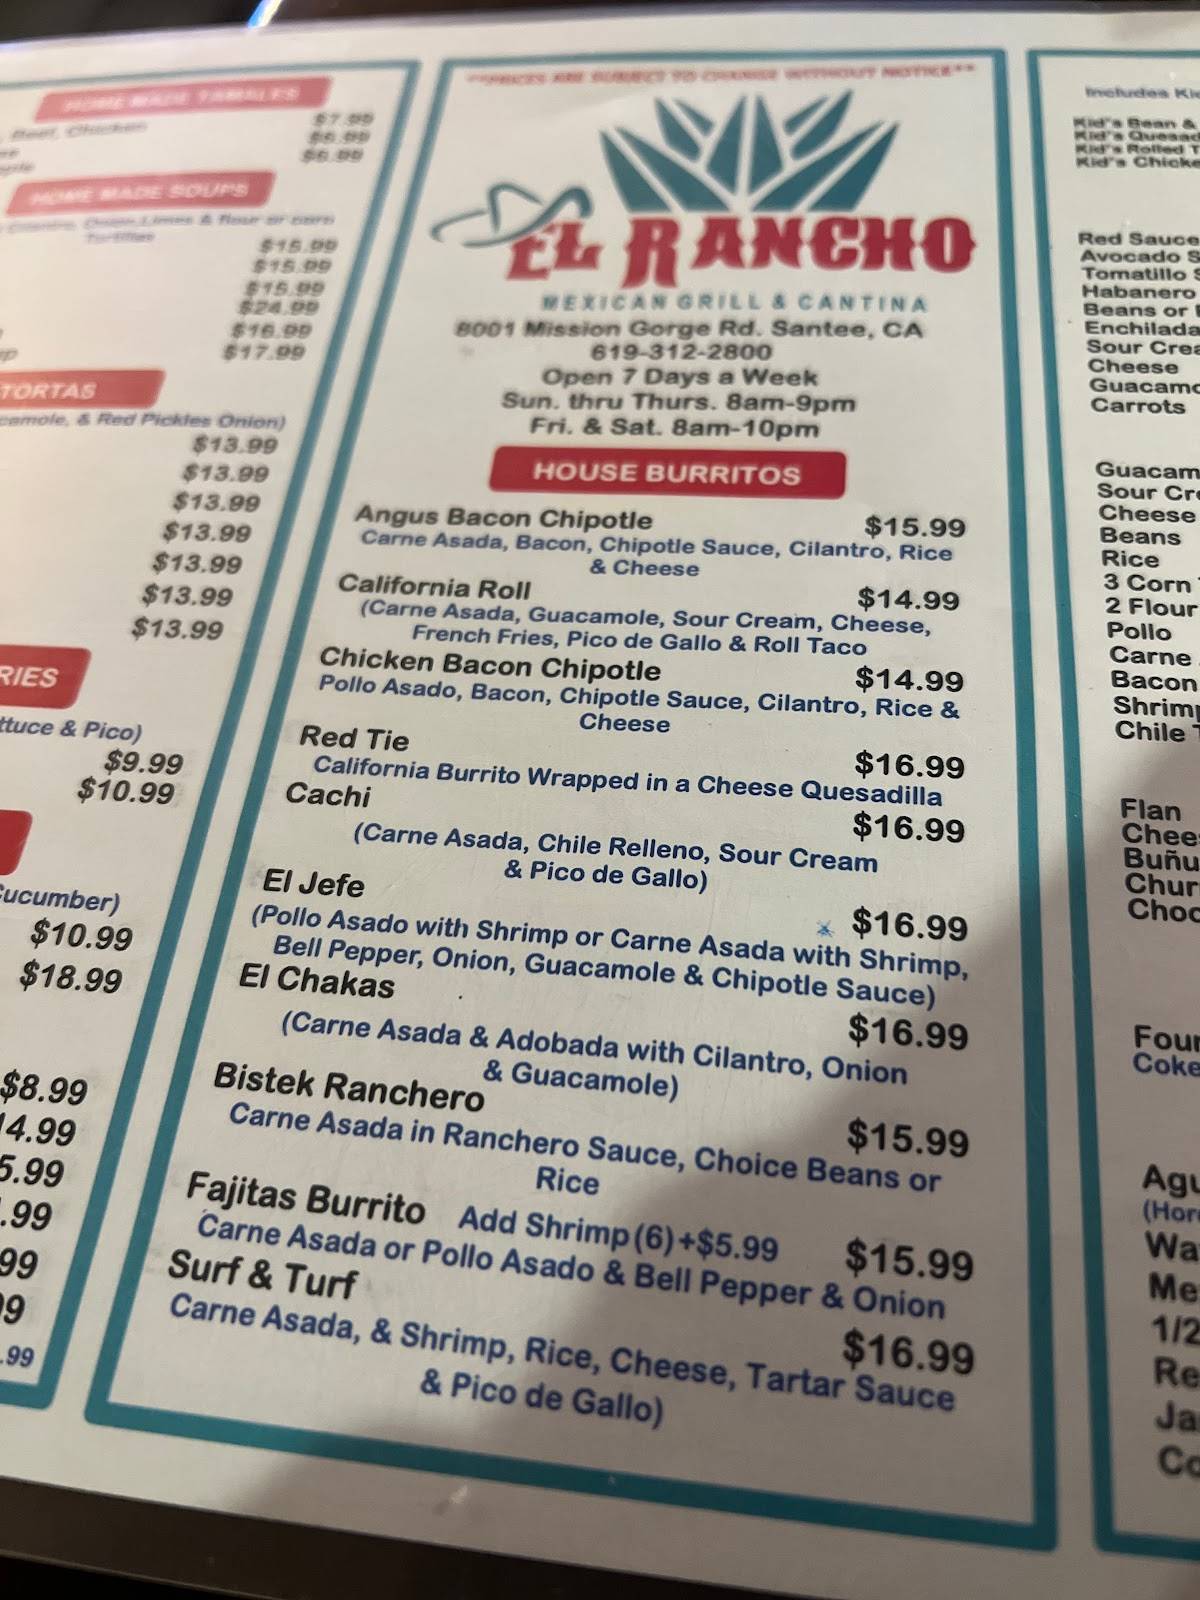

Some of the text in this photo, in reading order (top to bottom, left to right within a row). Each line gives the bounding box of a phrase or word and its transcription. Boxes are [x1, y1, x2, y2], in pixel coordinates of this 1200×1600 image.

[1073, 117, 1196, 129] Kid's Bean &
[1074, 131, 1123, 142] Kid's
[1075, 144, 1183, 155] Kid's Rolled
[1076, 157, 1126, 168] Kid's
[1079, 233, 1200, 246] Red Sauce
[505, 216, 977, 289] EL RANCHO
[1080, 251, 1181, 264] Avocado
[1082, 267, 1187, 281] Tomatillo
[1082, 285, 1196, 299] Habanero
[541, 294, 929, 314] MEXICAN GRILL & CANTINA
[1084, 304, 1188, 317] Beans or
[455, 319, 923, 340] 8001 Mission Gorge Rd. Santee, CA
[221, 344, 305, 362] $17.99
[592, 344, 772, 360] 619-312-2800
[1087, 340, 1142, 355] Sour
[542, 368, 818, 388] Open 7 Days a Week
[1088, 359, 1178, 374] Cheese
[1, 382, 97, 400] TORTAS
[502, 391, 856, 416] Sun. thru Thurs. 8am-9pm
[1091, 399, 1186, 415] Carrots
[77, 413, 286, 432] & Red Pickles Onion)
[531, 416, 819, 440] Fri. & Sat. 8am-10pm
[191, 434, 278, 456] $13.99
[182, 463, 269, 484] $13.99
[534, 463, 800, 485] HOUSE BURRITOS
[172, 491, 261, 513] $13.99
[1098, 483, 1157, 500] Sour
[354, 504, 653, 533] Angus Bacon Chipotle
[1099, 504, 1197, 523] Cheese
[162, 521, 252, 544] $13.99
[865, 514, 966, 539] $15.99
[1100, 527, 1182, 545] Beans
[152, 551, 242, 575] $13.99
[590, 559, 700, 576] & Cheese
[1102, 550, 1160, 568] Rice
[338, 573, 531, 600] California Roll
[1104, 573, 1191, 593] 3 Corn
[141, 583, 233, 608] $13.99
[858, 586, 960, 612] $14.99
[1106, 597, 1198, 618] 2 Flour
[131, 616, 224, 641] $13.99
[1107, 621, 1172, 641] Pollo
[320, 646, 661, 684] Chicken Bacon Chipotle
[1109, 645, 1191, 667] Carne
[856, 665, 964, 693] $14.99
[1111, 670, 1198, 692] Bacon
[60, 720, 143, 746] & Pico)
[580, 713, 670, 733] Cheese
[1115, 720, 1185, 742] Chile
[300, 725, 409, 752] Red Tie
[104, 749, 184, 776] $9.99
[855, 749, 965, 779] $16.99
[77, 776, 176, 805] $10.99
[314, 755, 942, 807] California Burrito Wrapped in a Cheese Quesadilla
[286, 782, 371, 808] Cachi
[1120, 798, 1182, 822] Flan
[853, 810, 965, 843] $16.99
[263, 868, 365, 898] El Jefe
[30, 917, 134, 952] $10.99
[852, 905, 968, 941] $16.99
[19, 958, 124, 996] $18.99
[239, 963, 395, 999] El Chakas
[849, 1012, 968, 1051] $16.99
[0, 1068, 88, 1107] $8.99
[214, 1062, 485, 1112] Bistek Ranchero
[848, 1117, 969, 1158] $15.99
[187, 1171, 426, 1225] Fajitas Burrito
[458, 1205, 517, 1234] Add
[198, 1214, 945, 1319] Carne Asada or Pollo Asado & Bell Pepper & Onion
[846, 1237, 973, 1282] $15.99
[168, 1249, 360, 1300] Surf & Turf
[843, 1328, 974, 1375] $16.99
